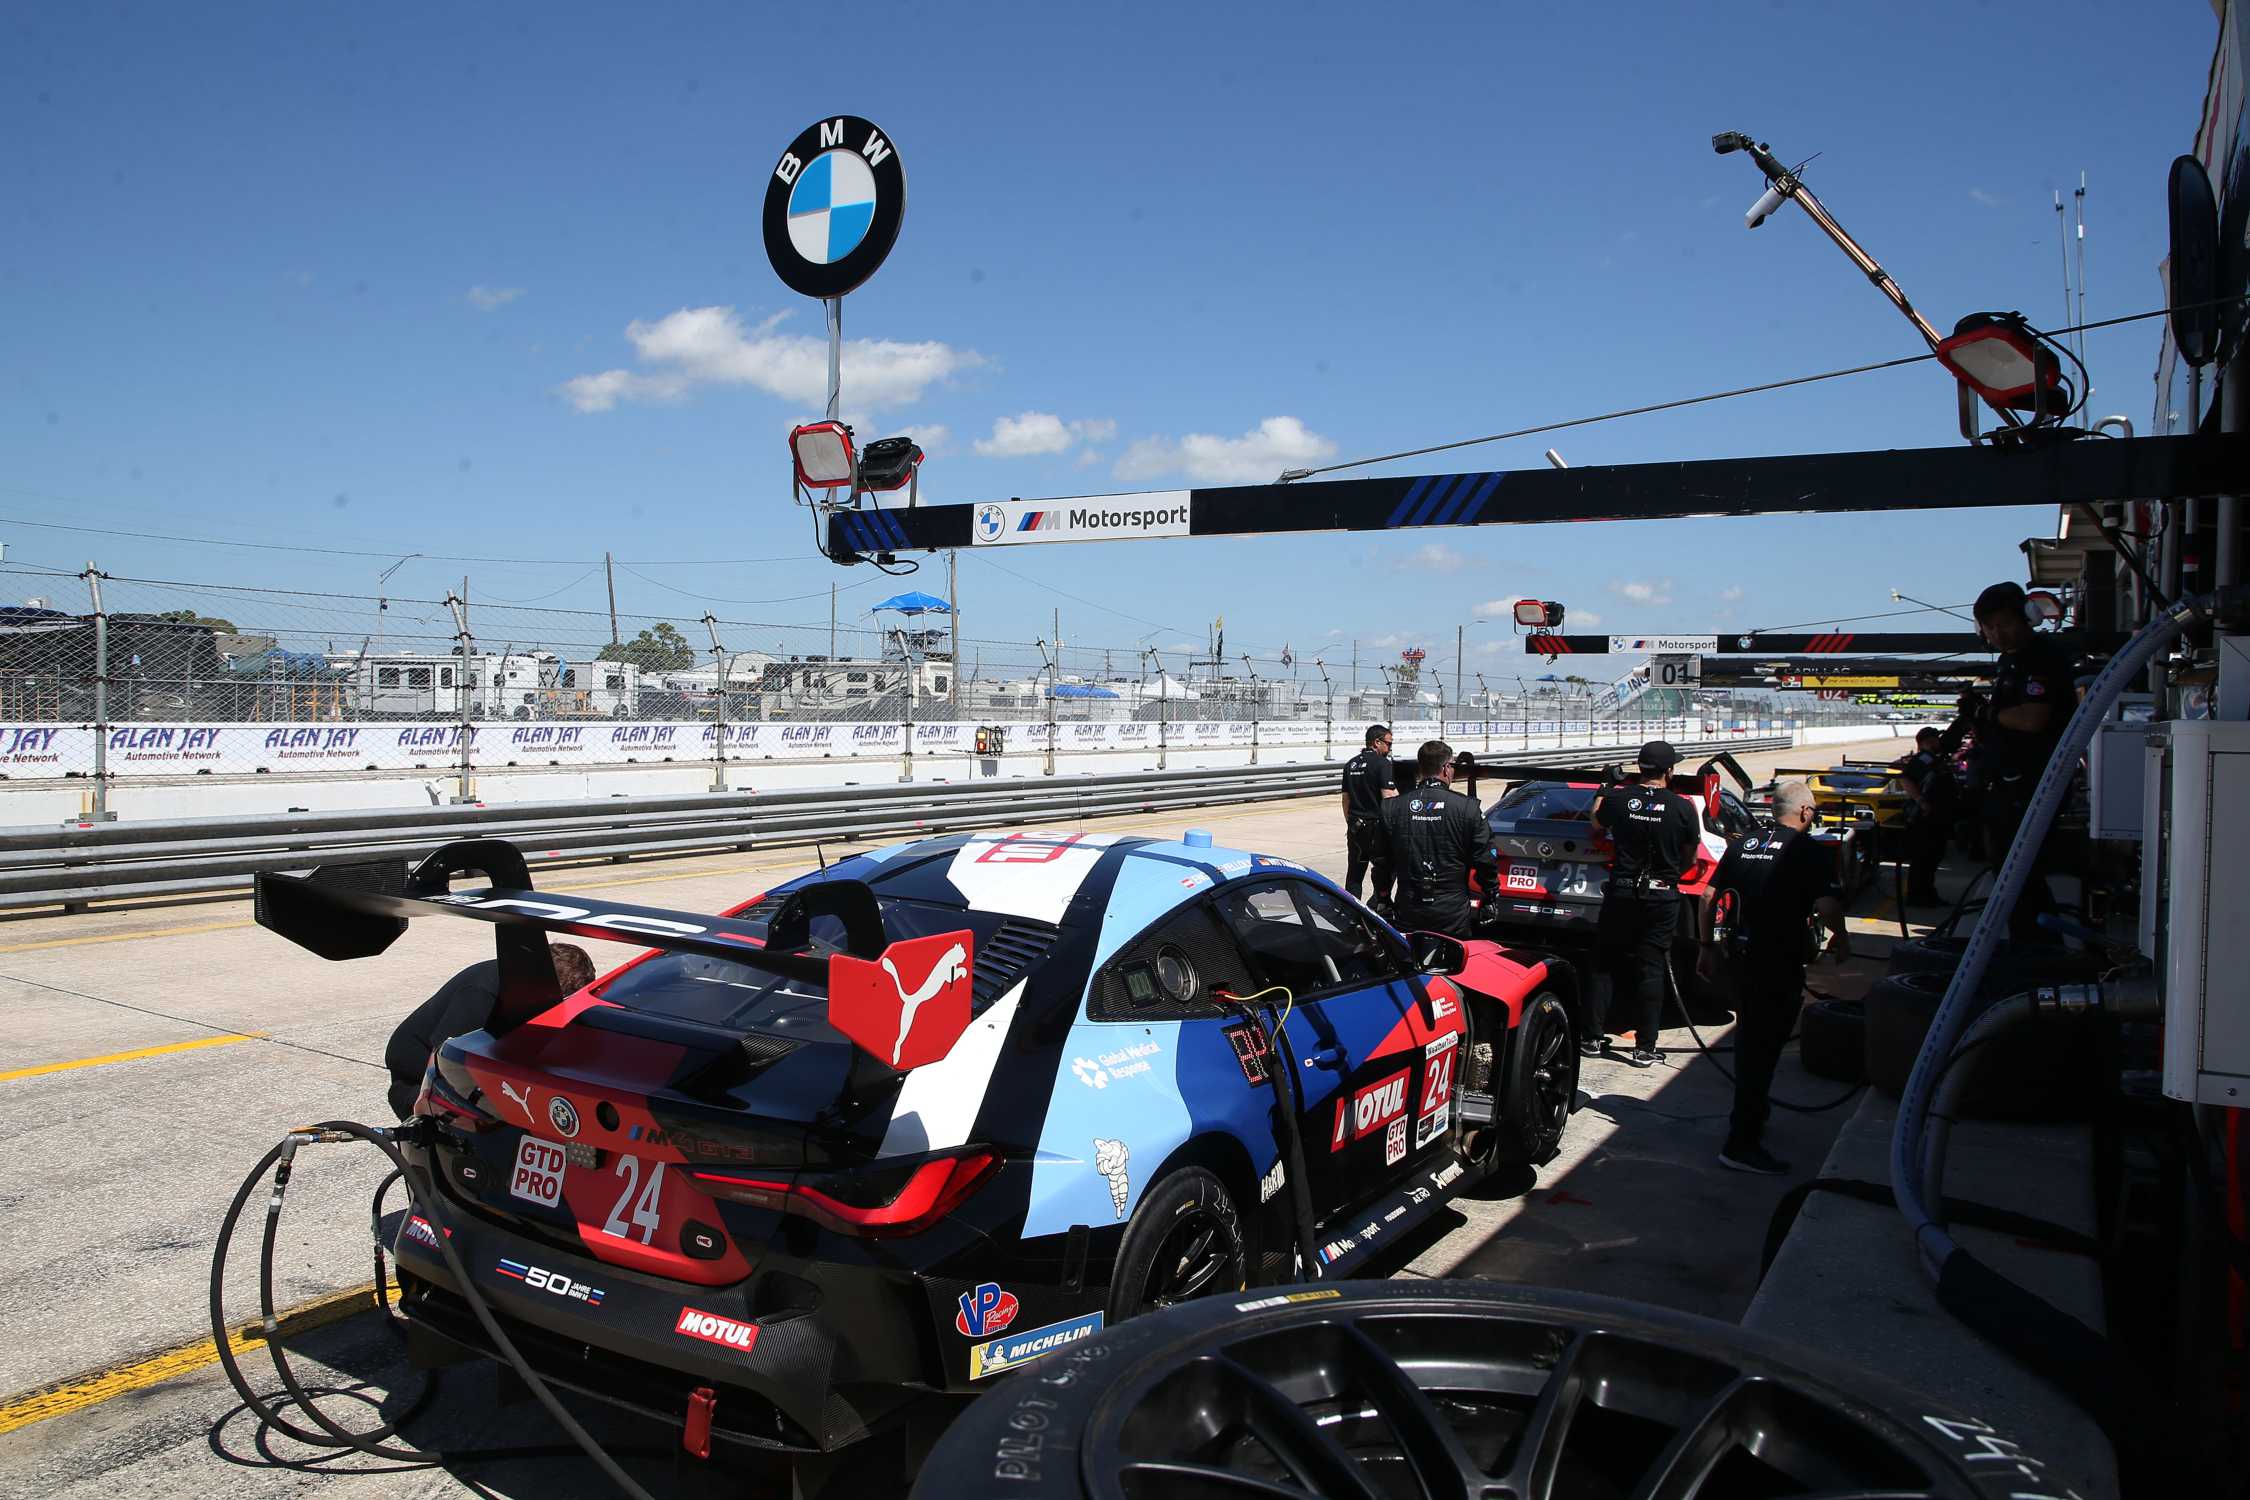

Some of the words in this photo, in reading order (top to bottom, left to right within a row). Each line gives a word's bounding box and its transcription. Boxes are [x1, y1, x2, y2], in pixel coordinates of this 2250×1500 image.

[775, 119, 891, 185] BMW
[1069, 505, 1188, 529] Motorsport
[1658, 640, 1717, 651] Motorsport
[1661, 664, 1689, 685] 01
[110, 728, 175, 750] ALAN
[177, 728, 222, 751] JAY
[265, 728, 321, 748] ALAN
[323, 728, 359, 749] JAY
[398, 728, 445, 747] ALAN
[512, 727, 550, 744] ALAN
[554, 727, 583, 745] JAY
[611, 727, 648, 743] ALAN
[650, 727, 677, 743] JAY
[703, 726, 734, 741] ALN
[736, 726, 759, 742] JAY
[781, 726, 809, 740] ALAN
[811, 726, 832, 741] JAY
[852, 726, 879, 739] ALAN
[880, 726, 899, 740] JAY
[917, 726, 941, 738] ALAN
[942, 725, 958, 739] JAY
[1027, 725, 1048, 736] ALAN
[1074, 725, 1093, 736] ALAN
[1093, 725, 1106, 736] JAY
[1119, 724, 1135, 735] ALAN
[7, 728, 58, 754] JAY
[13, 753, 59, 763] Network
[125, 752, 180, 761] Automotive
[182, 751, 221, 760] Network
[278, 750, 325, 758] Automotive
[327, 749, 360, 758] Network
[1509, 876, 1535, 887] PRO
[1510, 866, 1537, 878] GTD
[1558, 863, 1589, 893] 25
[1424, 1052, 1451, 1111] 24
[1336, 1077, 1405, 1143] MOTUL
[1388, 1120, 1406, 1141] GTD
[520, 1142, 564, 1173] GTD
[1387, 1138, 1404, 1161] PRO
[514, 1169, 558, 1200] PRO
[602, 1154, 665, 1246] 24
[1412, 1189, 1431, 1204] AERO
[406, 1220, 440, 1248] MOTU
[1338, 1221, 1381, 1253] Mosport
[525, 1266, 572, 1296] 50
[571, 1282, 592, 1295] JAHRE
[568, 1289, 583, 1300] BMW
[958, 1282, 1002, 1336] VP
[986, 1302, 1018, 1328] Racing
[680, 1311, 753, 1347] MOTUL
[1010, 1325, 1093, 1359] MICHELIN
[995, 1396, 1058, 1481] PILOT
